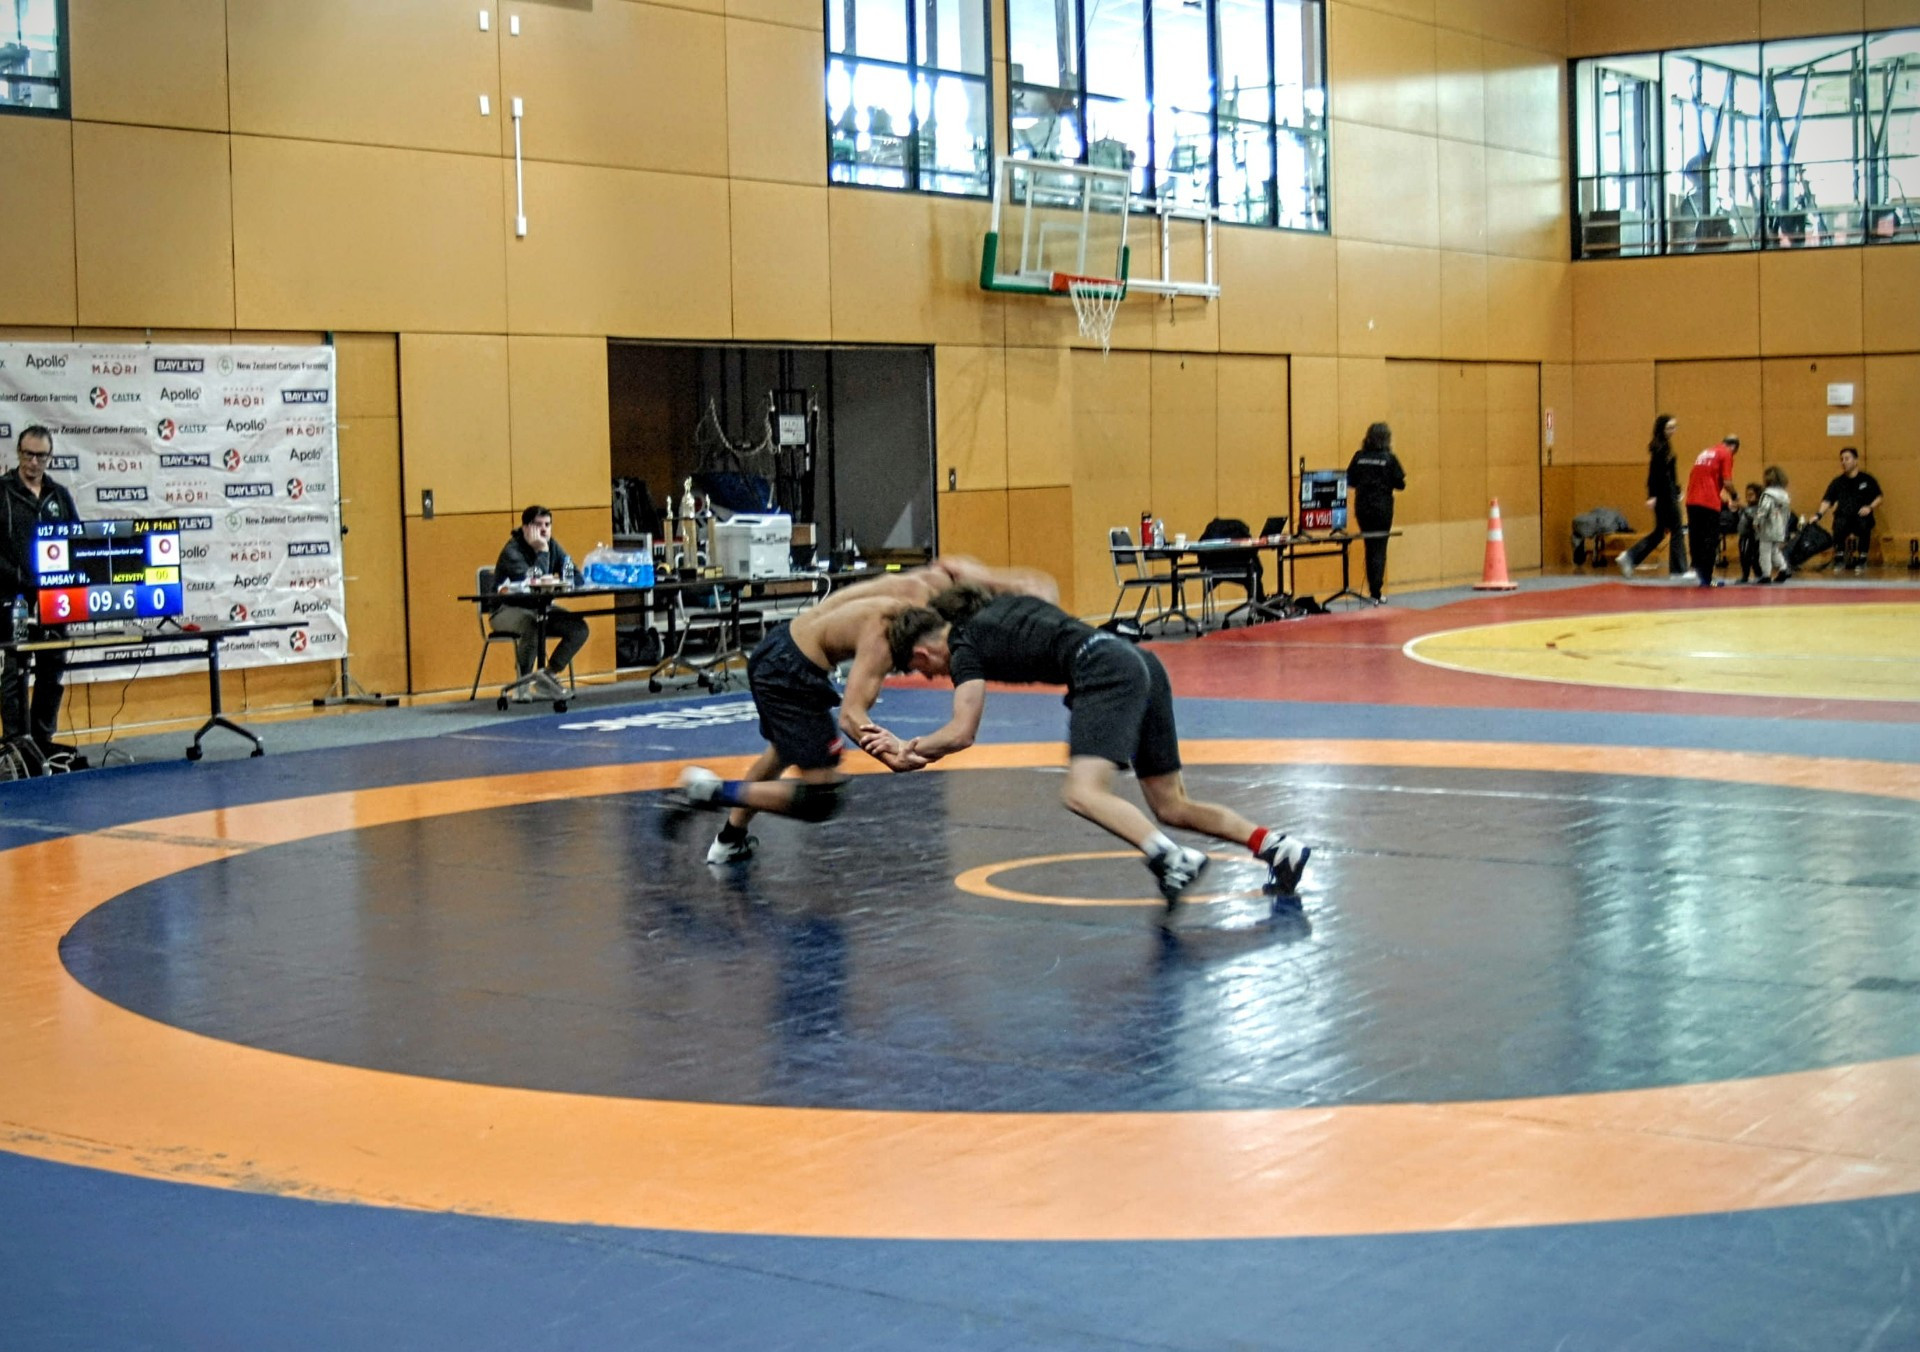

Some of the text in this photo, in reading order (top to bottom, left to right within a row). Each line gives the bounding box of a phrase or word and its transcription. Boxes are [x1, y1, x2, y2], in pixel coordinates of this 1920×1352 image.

[26, 354, 66, 369] Apollo
[157, 361, 202, 371] BAYLEYS
[0, 393, 77, 403] land Carbon Farming
[111, 393, 141, 402] CALTEX
[160, 387, 200, 402] Apollo
[284, 392, 326, 402] BAYLEYS
[92, 425, 118, 434] Carbon
[178, 424, 207, 433] CALTEX
[226, 419, 265, 433] Apollo
[162, 455, 208, 466] BAYLEYS
[98, 488, 146, 500] BAYLEYS
[227, 486, 270, 496] BAYLEYS
[102, 522, 116, 535] 74
[134, 521, 149, 533] 1/4
[180, 518, 210, 529] YLEYS
[38, 524, 84, 536] U17 FS 71
[180, 546, 207, 559] pollo
[290, 543, 329, 554] BAYLEYS
[40, 574, 75, 586] RAMSAY
[57, 588, 165, 617] 3 09.6 0
[310, 634, 336, 643] CALTEX
